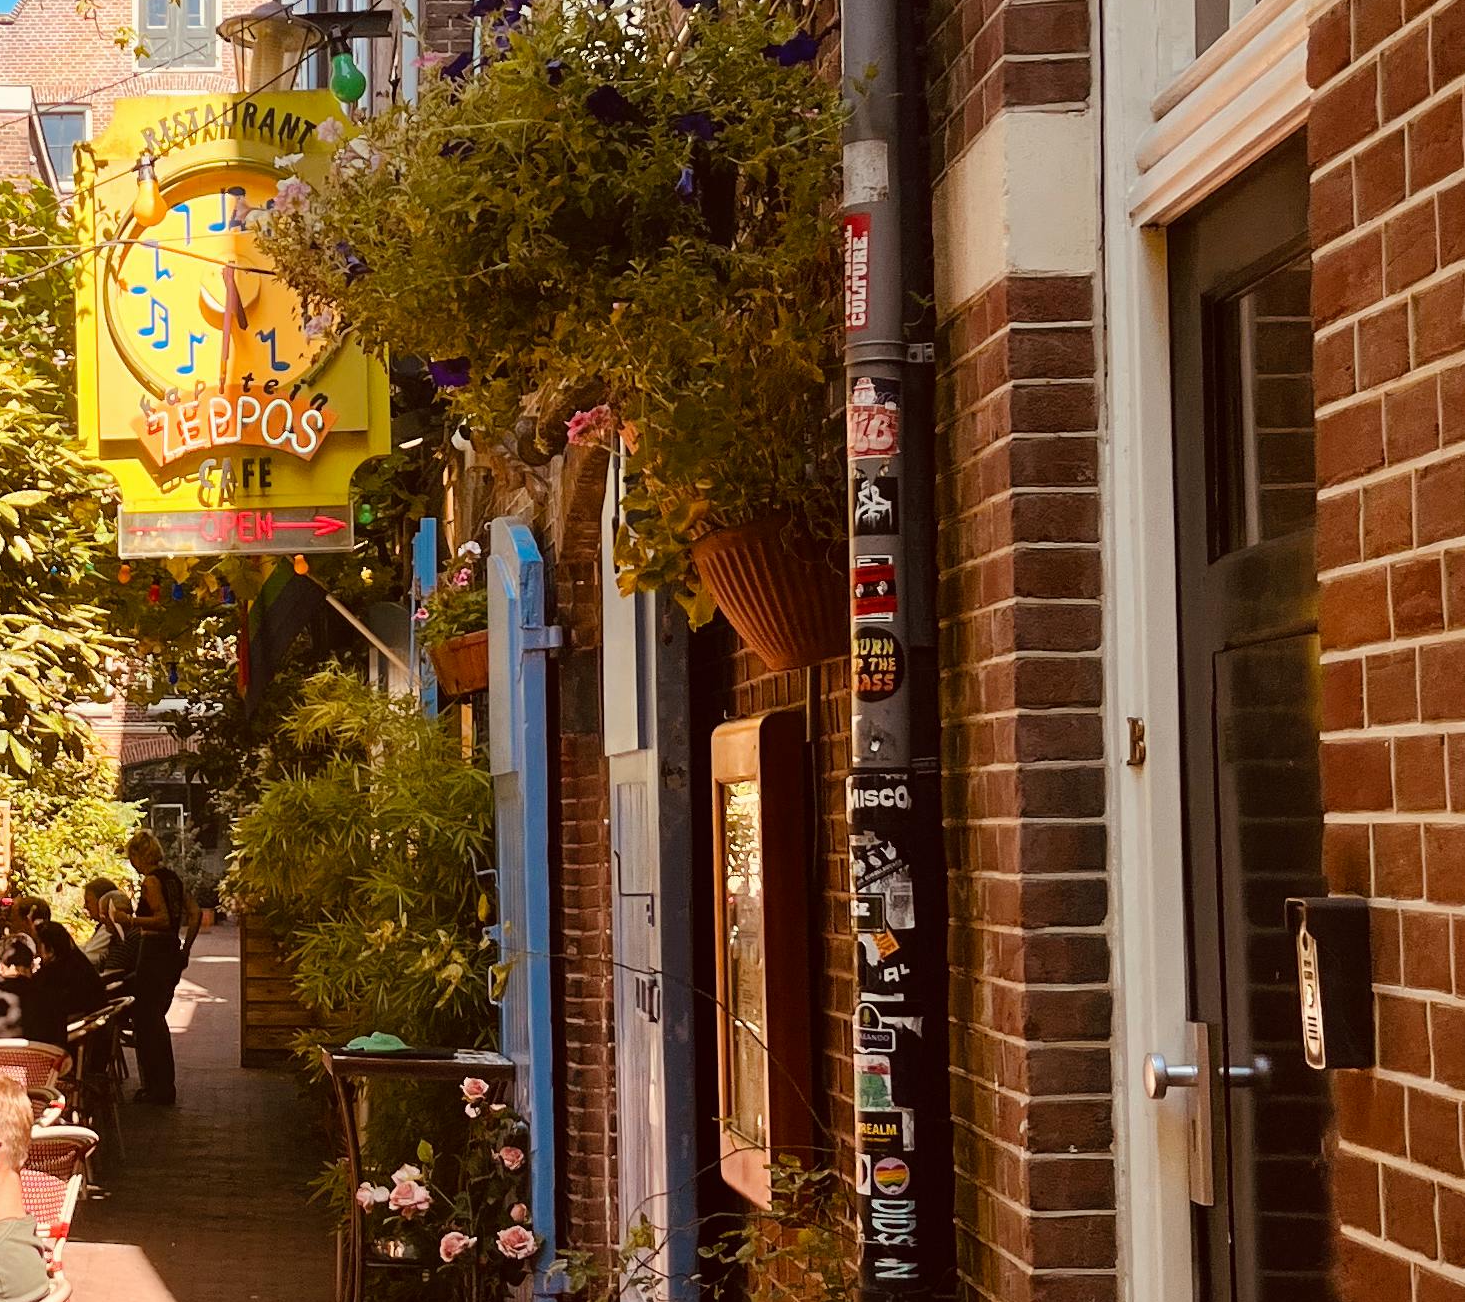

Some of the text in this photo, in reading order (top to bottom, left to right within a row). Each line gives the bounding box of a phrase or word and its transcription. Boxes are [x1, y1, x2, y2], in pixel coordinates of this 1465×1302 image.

[140, 101, 317, 152] RESTAURANT
[147, 395, 324, 459] ZEPPOS
[198, 457, 273, 489] CAFE
[199, 511, 274, 543] OPEN
[868, 657, 896, 672] THE
